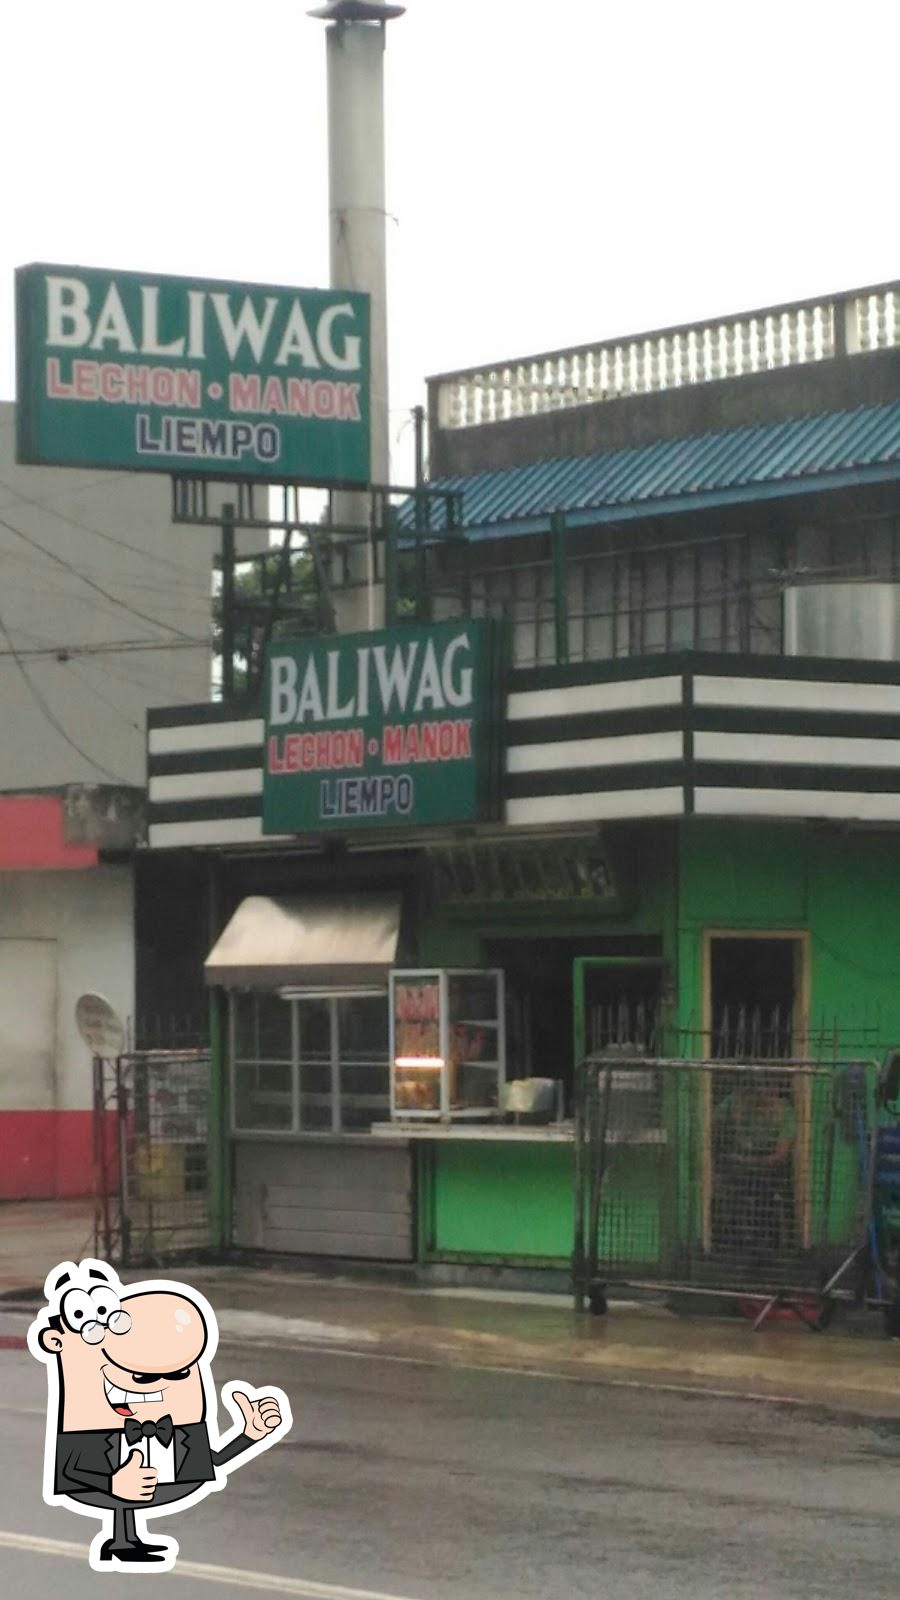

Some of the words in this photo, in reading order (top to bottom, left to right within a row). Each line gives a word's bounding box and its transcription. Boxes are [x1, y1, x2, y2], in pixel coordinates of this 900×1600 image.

[45, 276, 361, 371] BALIWAG
[46, 357, 200, 408] LECHON
[229, 372, 361, 421] MANOK
[136, 414, 280, 462] LIEMPO
[269, 632, 473, 725] BALIWAG
[268, 728, 364, 774] LECHON
[382, 719, 472, 765] MANOK
[320, 774, 413, 819] LIEMPO
